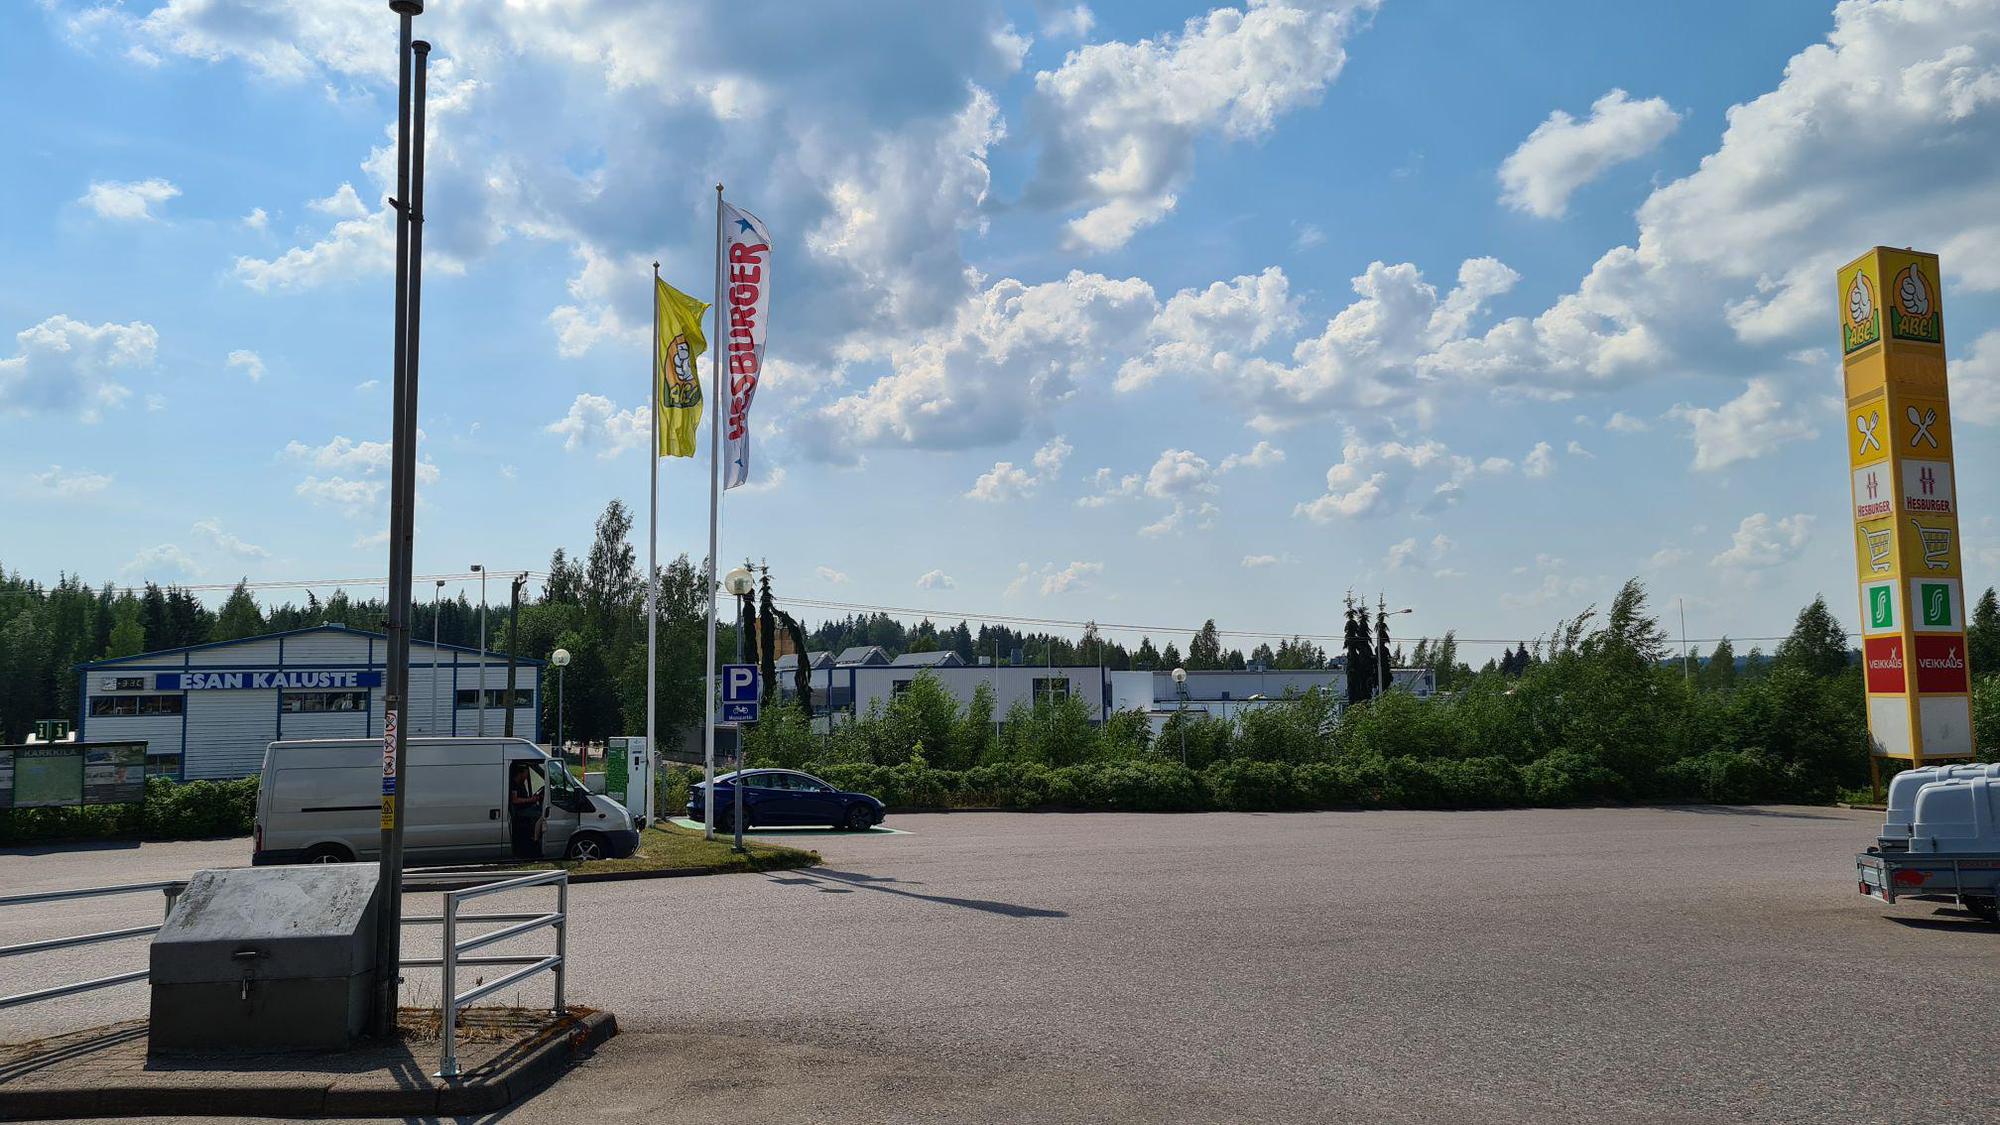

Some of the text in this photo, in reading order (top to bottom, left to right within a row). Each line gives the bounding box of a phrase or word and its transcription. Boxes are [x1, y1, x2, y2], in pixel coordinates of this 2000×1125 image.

[1899, 316, 1932, 337] ABC!
[727, 242, 769, 441] HESBURGER
[1857, 500, 1891, 517] HESBURGER
[1906, 496, 1950, 513] HESBURGER
[1868, 657, 1903, 669] VEIKKAUS
[1919, 658, 1964, 669] VEIKKAUS
[179, 672, 358, 690] ESAN KALUSTE
[730, 668, 753, 699] P
[24, 748, 78, 757] KARKKILA
